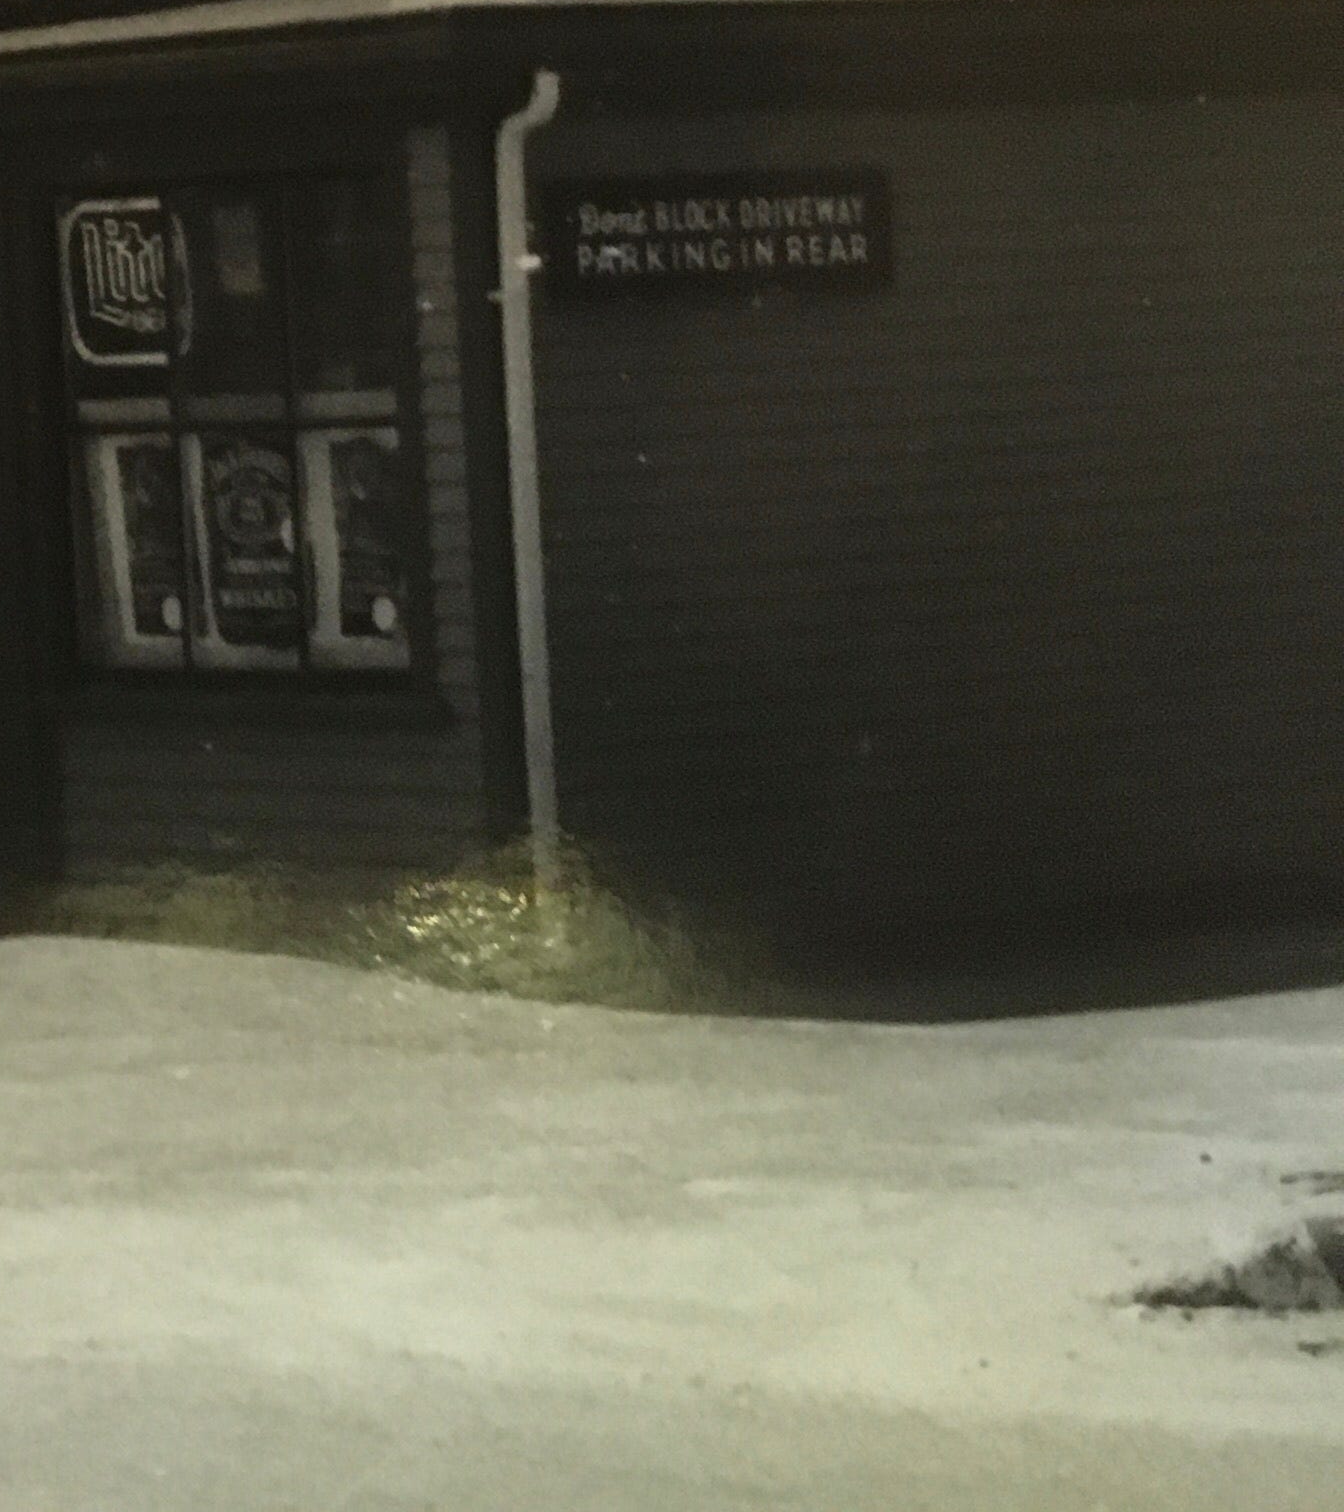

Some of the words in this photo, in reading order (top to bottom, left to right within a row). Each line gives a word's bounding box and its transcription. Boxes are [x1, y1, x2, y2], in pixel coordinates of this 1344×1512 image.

[576, 238, 731, 274] PARKING
[740, 237, 775, 268] IN
[784, 232, 870, 266] REAR
